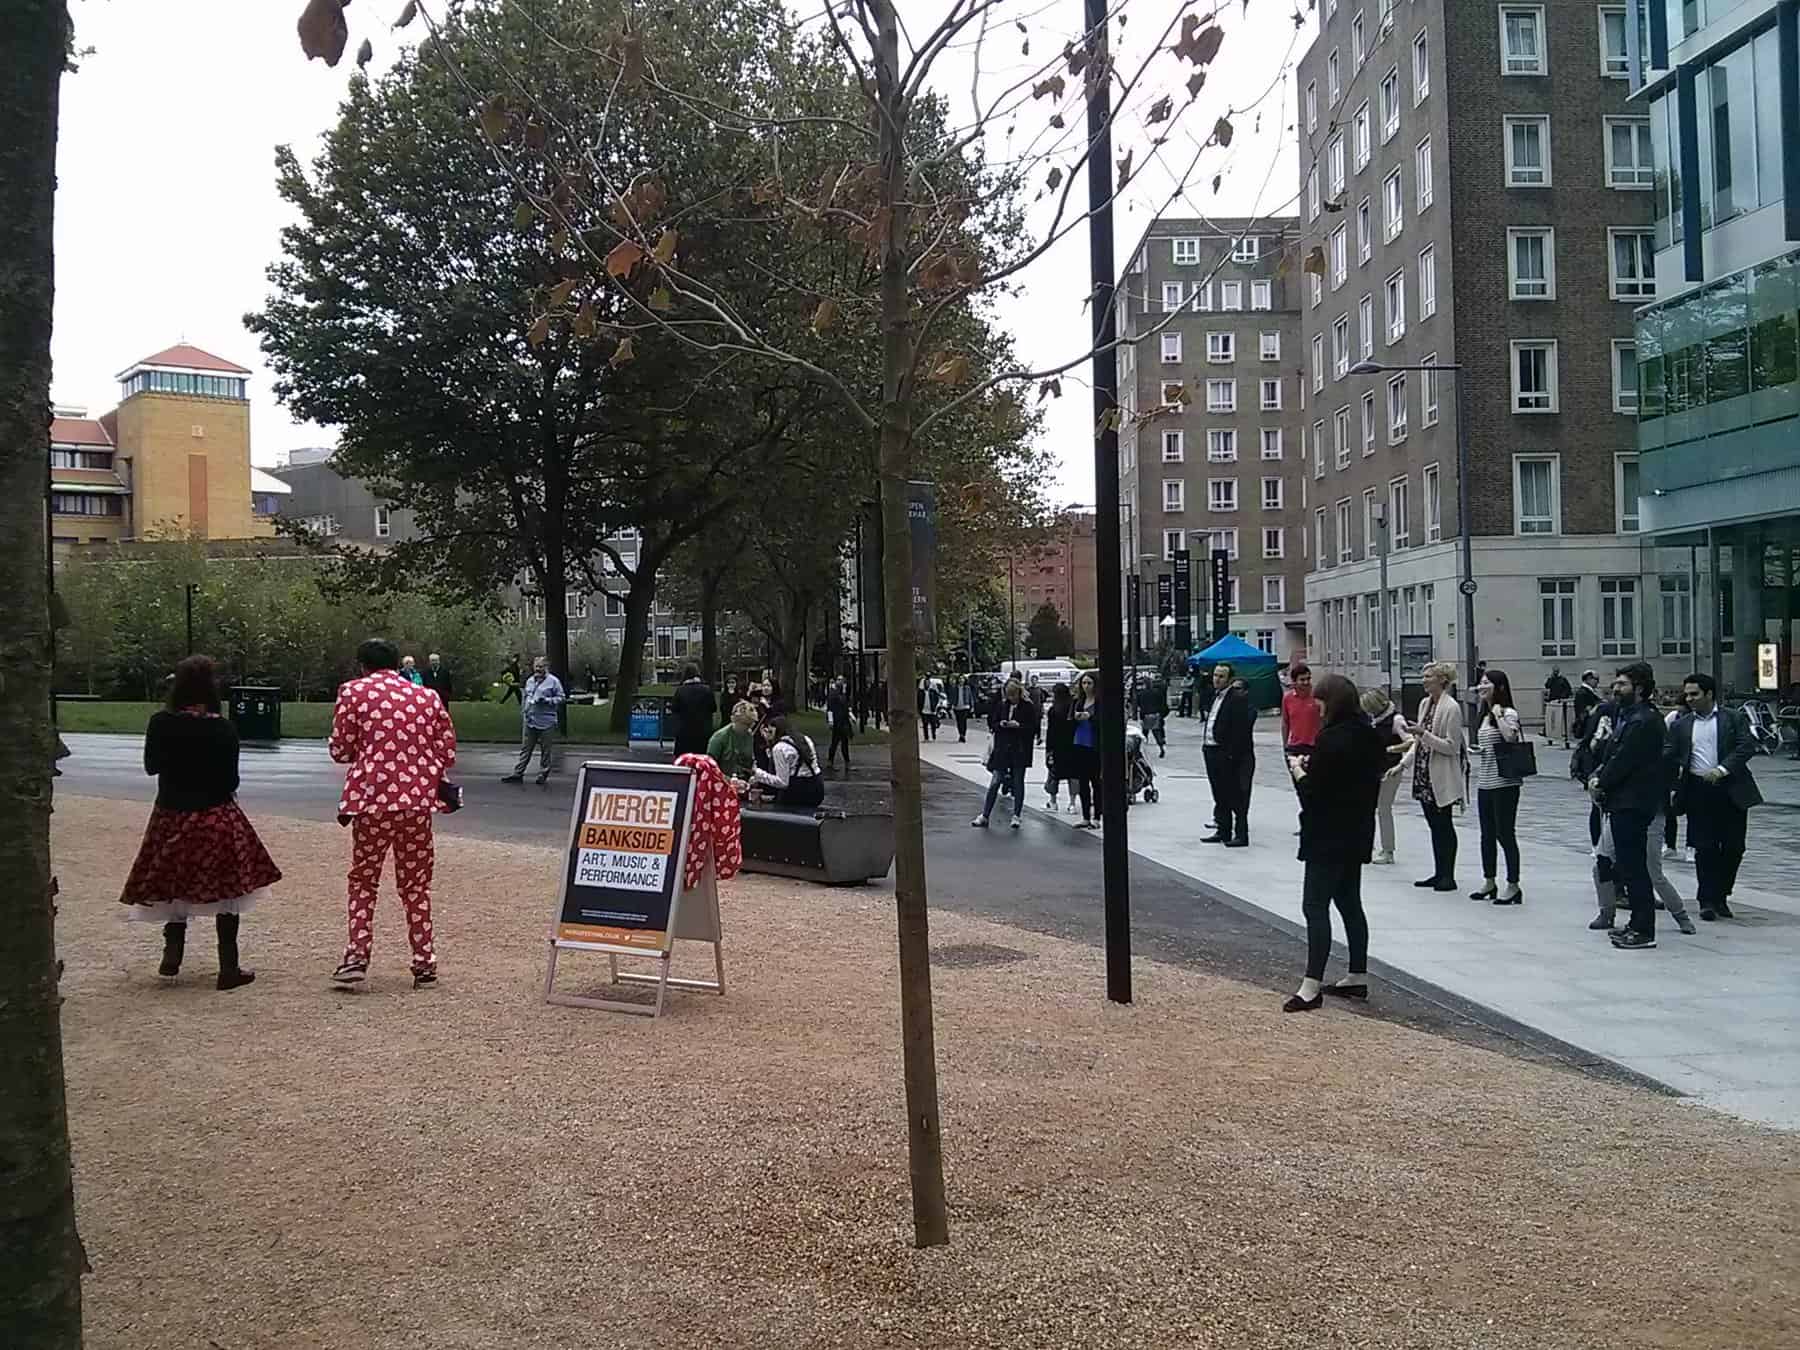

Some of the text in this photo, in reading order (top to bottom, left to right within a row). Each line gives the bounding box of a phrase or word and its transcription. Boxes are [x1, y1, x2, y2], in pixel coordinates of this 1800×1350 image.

[590, 793, 673, 825] MERGE
[585, 827, 667, 850] BANKSIDE
[582, 852, 660, 870] ART, MUSIC &
[580, 868, 659, 887] PERFORMANCE
